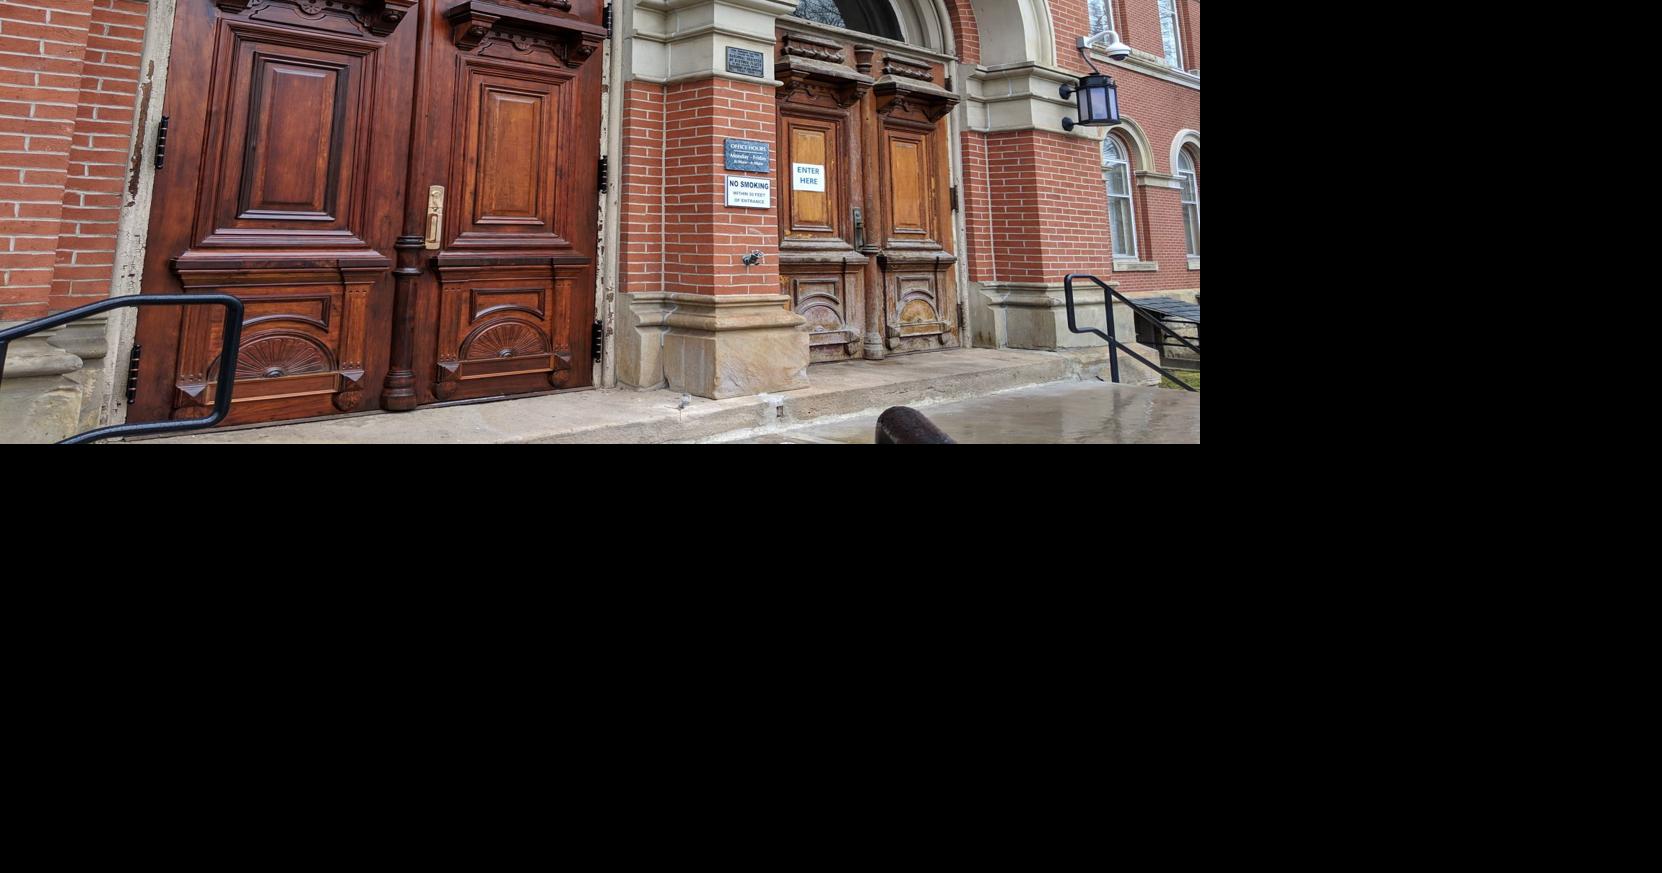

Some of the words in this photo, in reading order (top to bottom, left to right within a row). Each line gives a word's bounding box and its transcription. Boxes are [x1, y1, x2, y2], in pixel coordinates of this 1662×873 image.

[797, 167, 819, 175] ENTER
[800, 177, 818, 185] HERE
[740, 181, 769, 190] SMOKING
